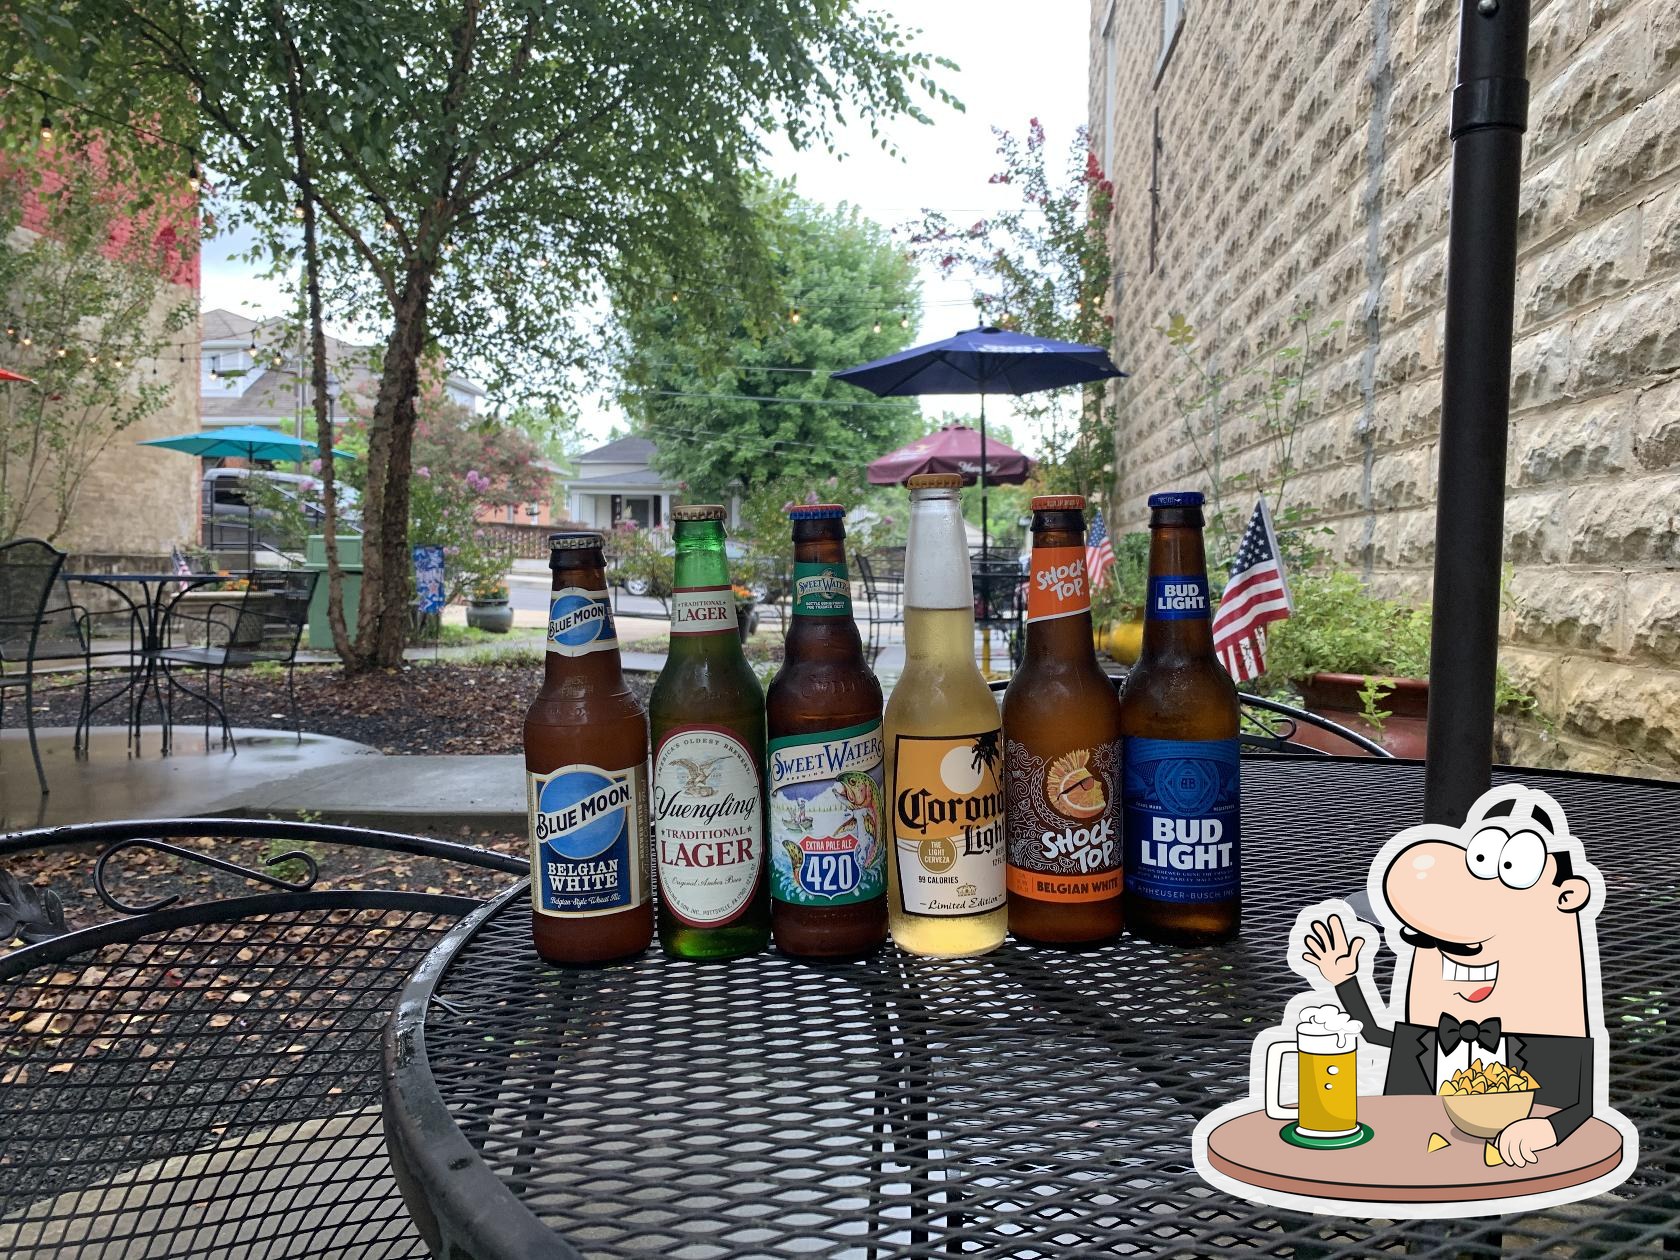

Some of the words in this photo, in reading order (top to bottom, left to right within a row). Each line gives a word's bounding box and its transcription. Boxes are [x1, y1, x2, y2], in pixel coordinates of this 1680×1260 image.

[1036, 558, 1085, 591] SHOCK
[1050, 577, 1083, 602] TOP
[1164, 584, 1199, 597] BUD
[681, 600, 723, 608] TRADITIONAL
[1157, 596, 1205, 610] LIGHT
[548, 616, 572, 638] BLUE
[573, 605, 604, 625] MOON
[677, 607, 728, 622] LAGER
[536, 808, 578, 840] BLUE
[580, 783, 630, 822] MOON
[655, 785, 759, 825] Yuengling
[898, 787, 1004, 835] Corona
[666, 826, 746, 840] TRADITIONAL
[1041, 817, 1114, 859] SHOCK
[1152, 816, 1223, 844] BUD
[660, 837, 754, 868] LAGER
[805, 840, 825, 851] EXTRA
[825, 840, 841, 851] PALE
[841, 838, 852, 849] ALE
[928, 848, 945, 856] LIGHT
[931, 841, 942, 849] THE
[924, 856, 950, 864] CERVEZA
[1070, 840, 1113, 874] TOP
[1141, 839, 1232, 870] LIGHT
[547, 858, 619, 876] BELGIAN
[806, 854, 853, 891] 420
[549, 871, 618, 892] WHITE
[918, 875, 926, 884] 99
[927, 876, 959, 884] CALORIES
[1036, 880, 1089, 895] BELGIAN
[1091, 877, 1118, 893] WHITE
[928, 899, 966, 910] Limited
